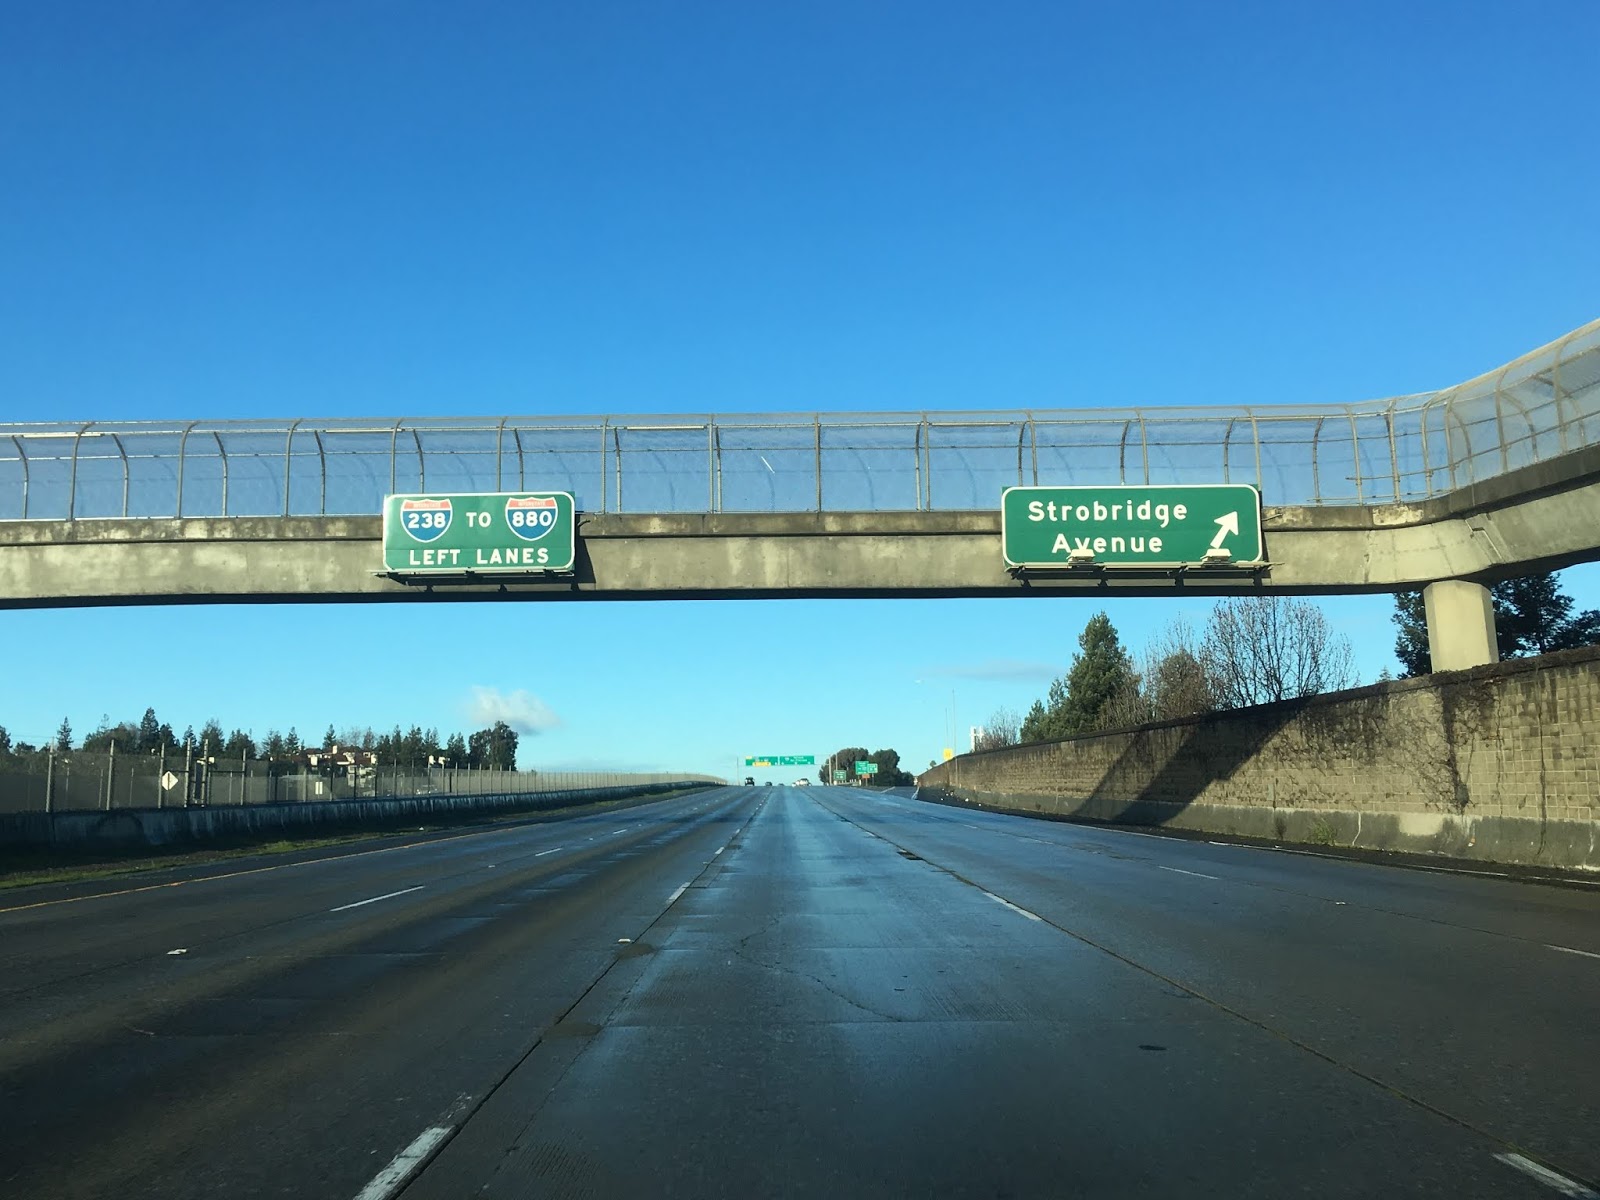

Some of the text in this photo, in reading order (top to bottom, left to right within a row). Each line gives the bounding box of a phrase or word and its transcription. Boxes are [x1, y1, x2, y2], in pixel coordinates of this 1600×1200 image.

[407, 510, 553, 529] 238 TO 880
[1028, 499, 1188, 528] Strobridge
[1051, 533, 1163, 554] Avenue
[409, 547, 549, 566] LEFT LANES
